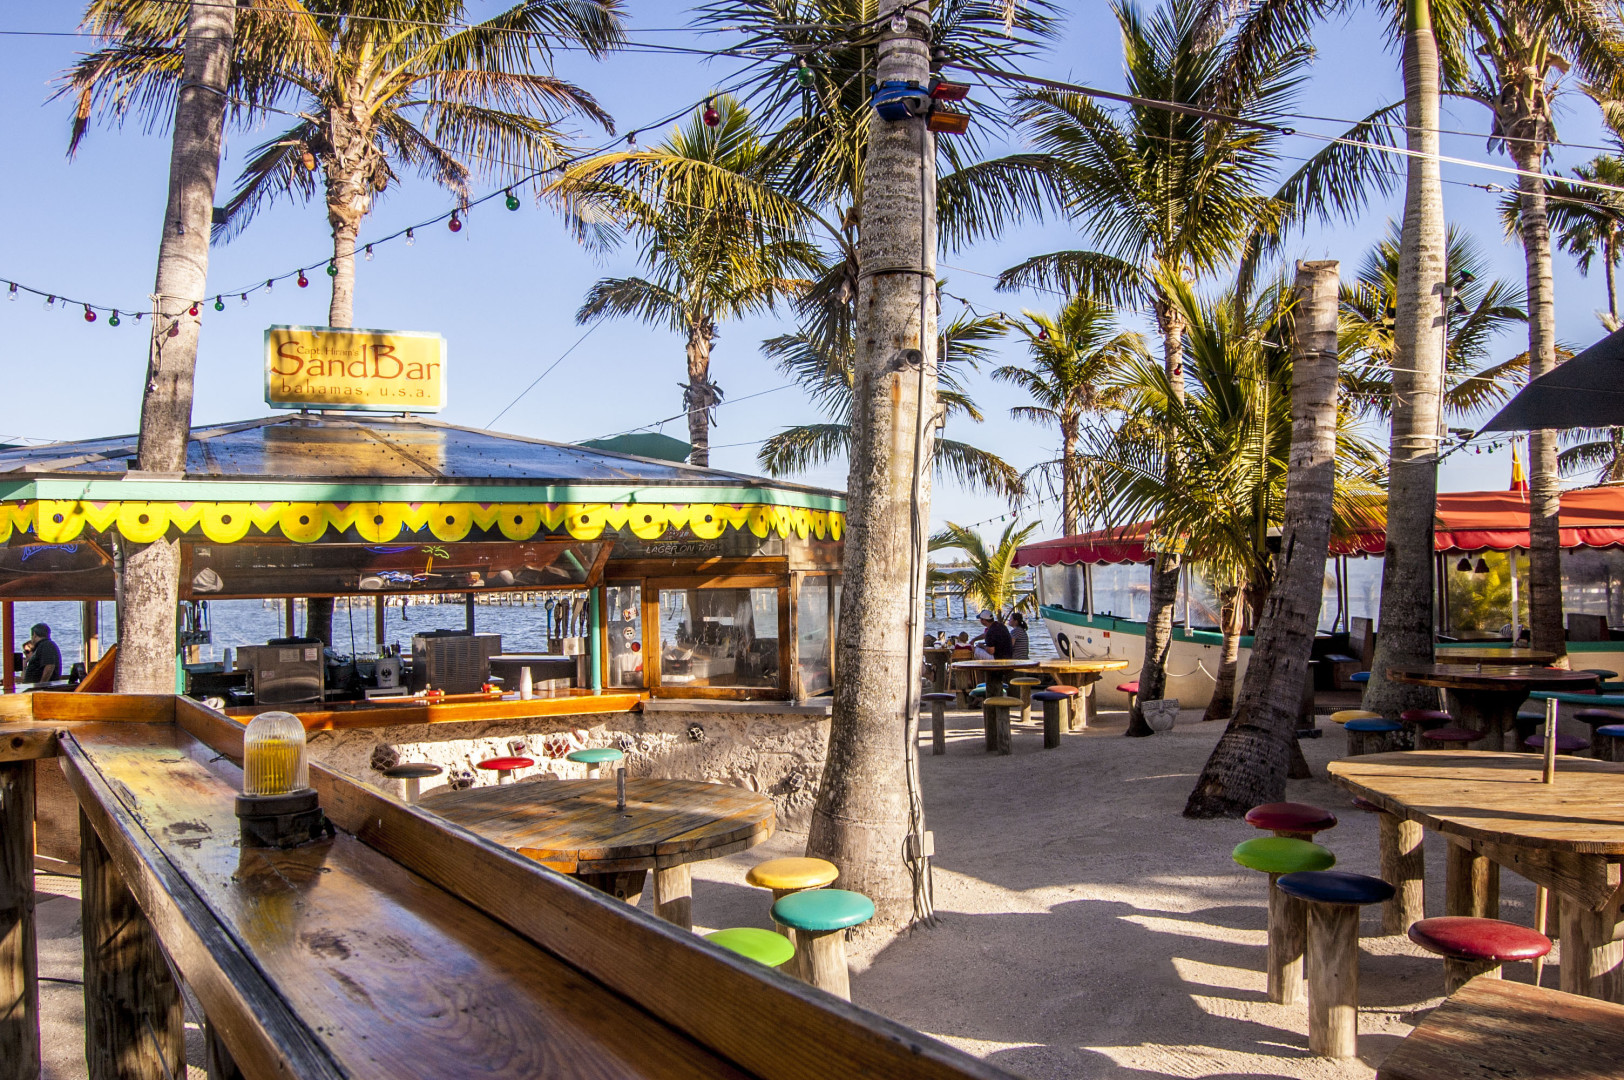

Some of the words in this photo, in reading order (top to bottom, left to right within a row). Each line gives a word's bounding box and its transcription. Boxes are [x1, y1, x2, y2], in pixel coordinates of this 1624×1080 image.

[296, 345, 323, 358] Capt.
[380, 387, 431, 398] u.s.a.
[646, 545, 678, 554] LAGER
[680, 544, 695, 552] ON
[698, 543, 716, 552] TAP
